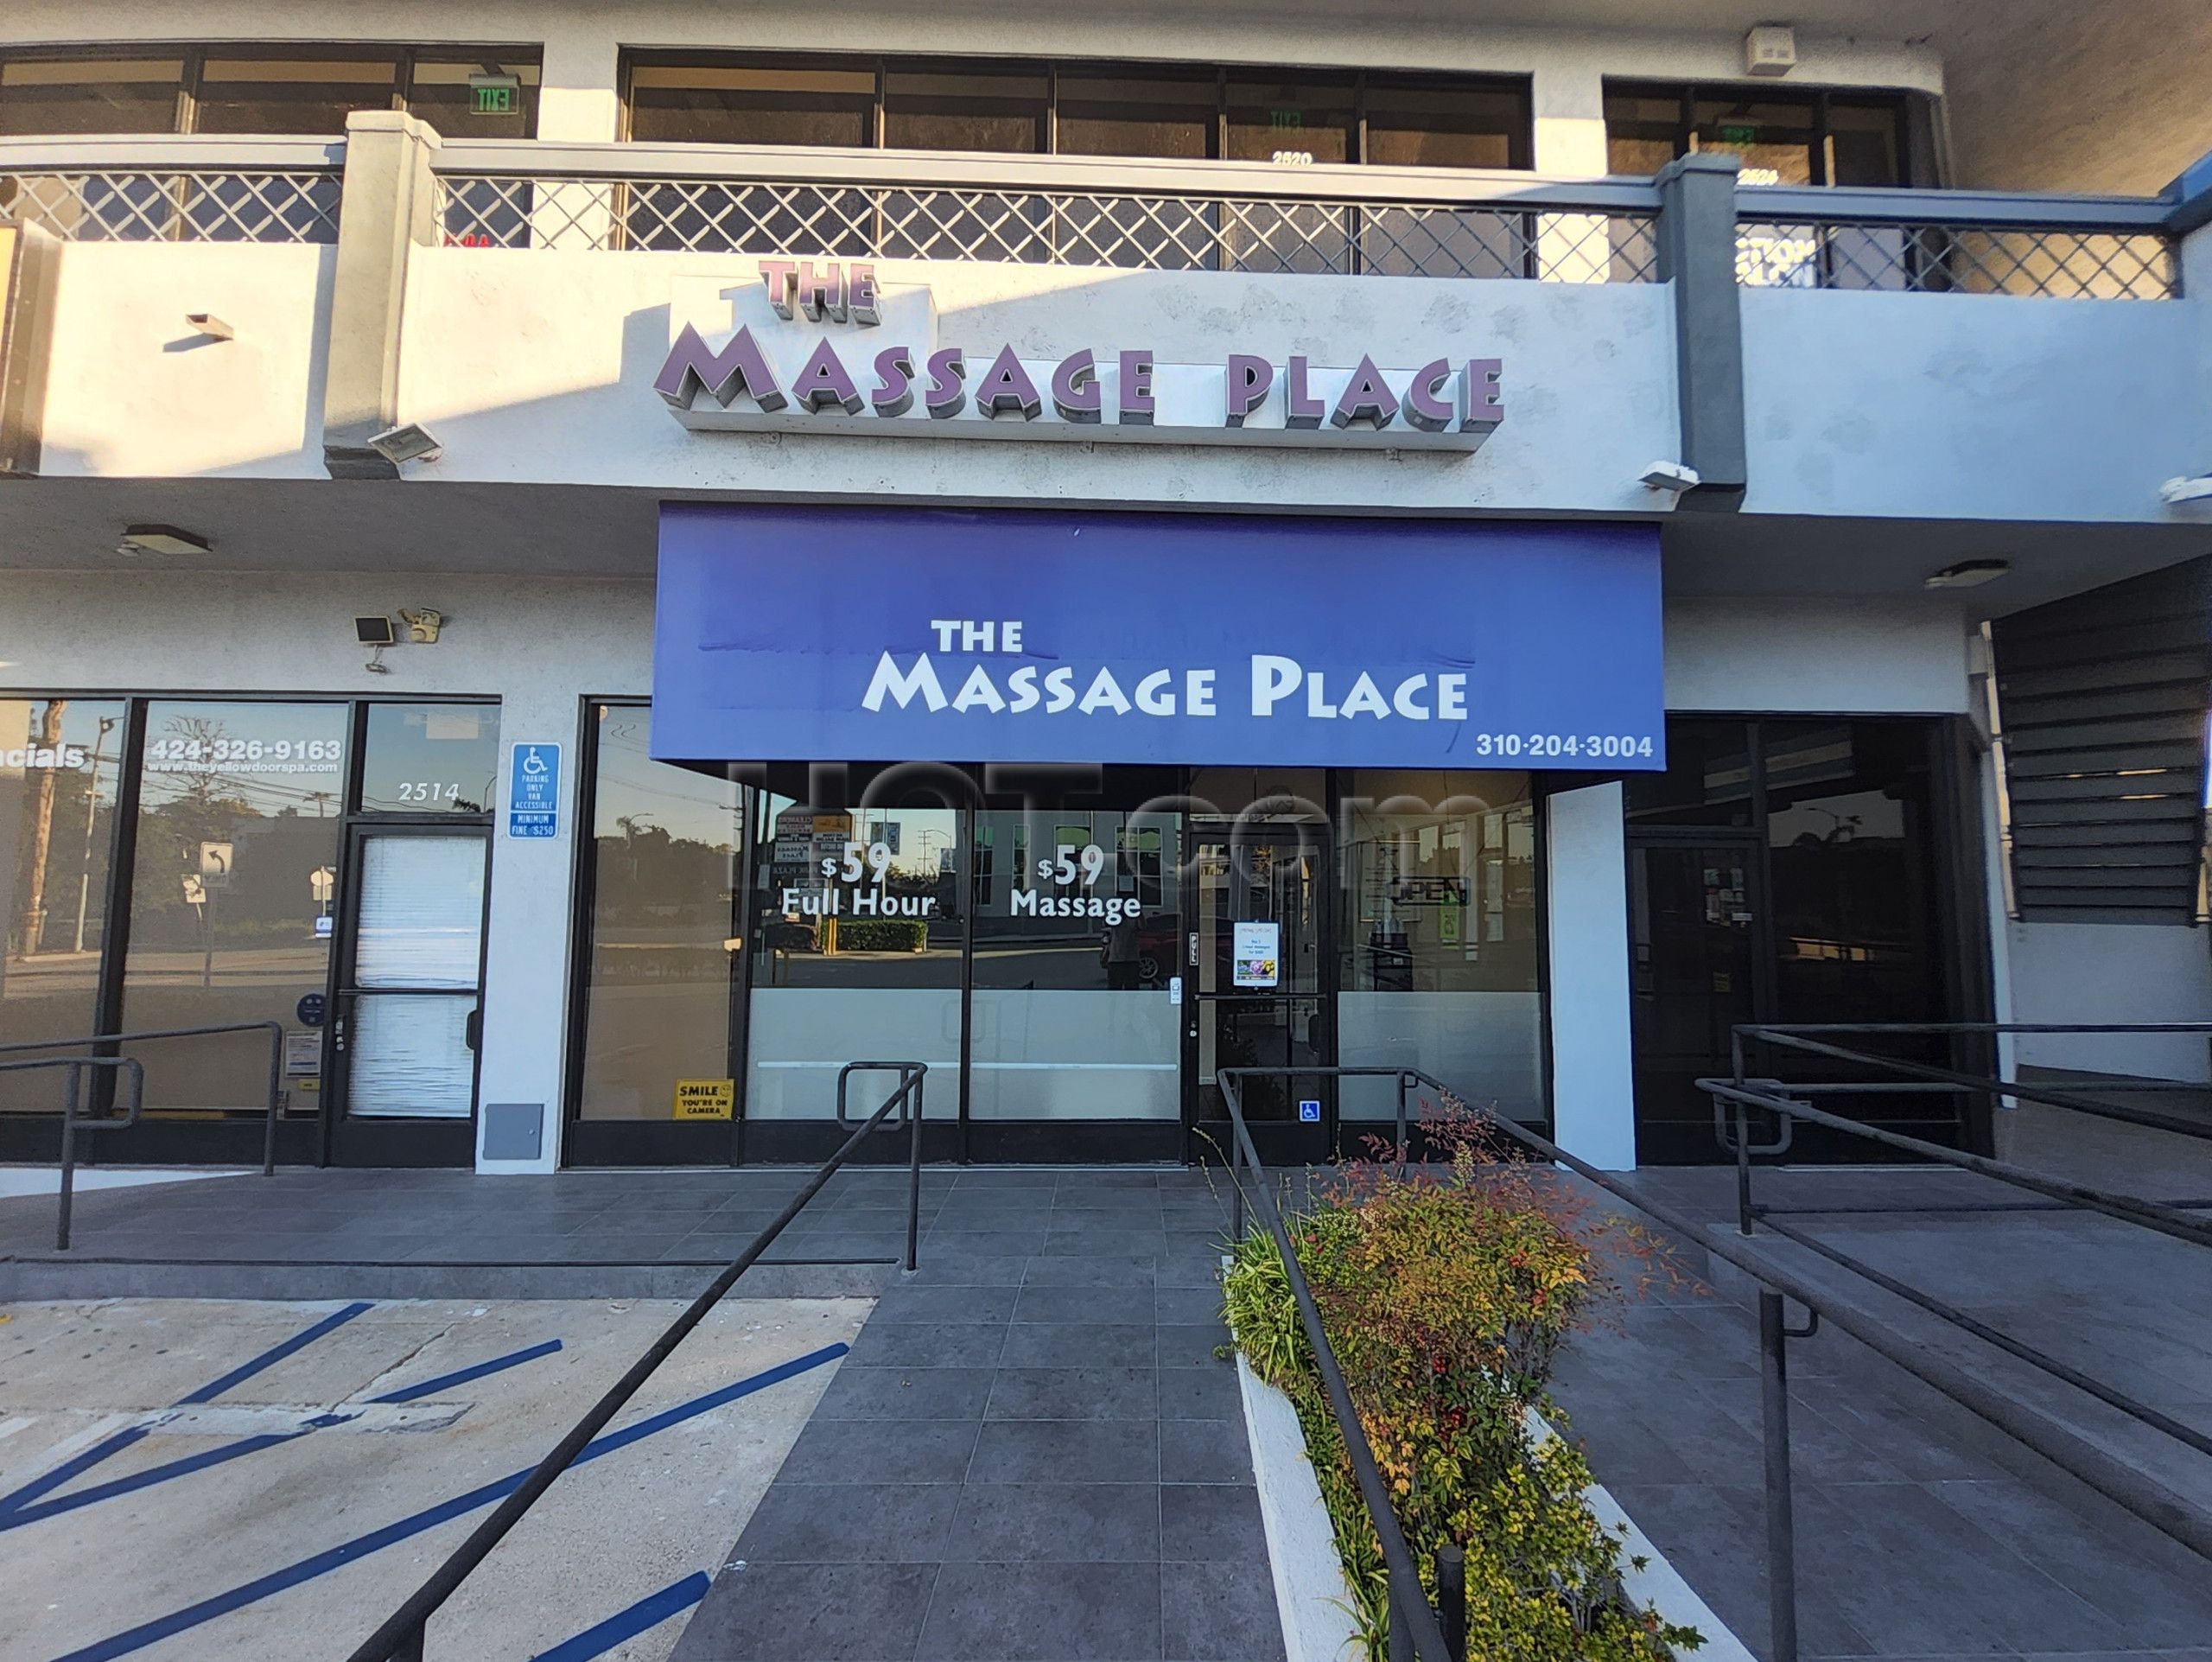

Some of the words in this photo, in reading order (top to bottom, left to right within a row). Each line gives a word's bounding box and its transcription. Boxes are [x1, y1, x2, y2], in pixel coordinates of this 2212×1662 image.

[759, 260, 876, 315] THE
[653, 321, 1156, 418] MASSAGE
[1226, 353, 1504, 428] PLACE
[931, 620, 1023, 653] THE
[861, 650, 1217, 716] MASSAGE
[1251, 654, 1468, 720] PLACE
[0, 742, 85, 768] cials
[149, 739, 342, 761] 424-326-9163
[146, 761, 339, 774] www.theyellowdoorspa.com
[522, 774, 549, 783] PARKING
[398, 782, 459, 801] 2514
[512, 825, 528, 835] FINE
[533, 825, 554, 836] $250
[518, 814, 550, 824] MINIMUM
[821, 842, 892, 883] $59
[1038, 844, 1104, 885] $59
[781, 887, 840, 915] Full
[853, 888, 936, 916] Hour
[1010, 888, 1141, 927] Massage
[679, 1086, 719, 1097] SMILE
[682, 1098, 713, 1107] YOU'RE
